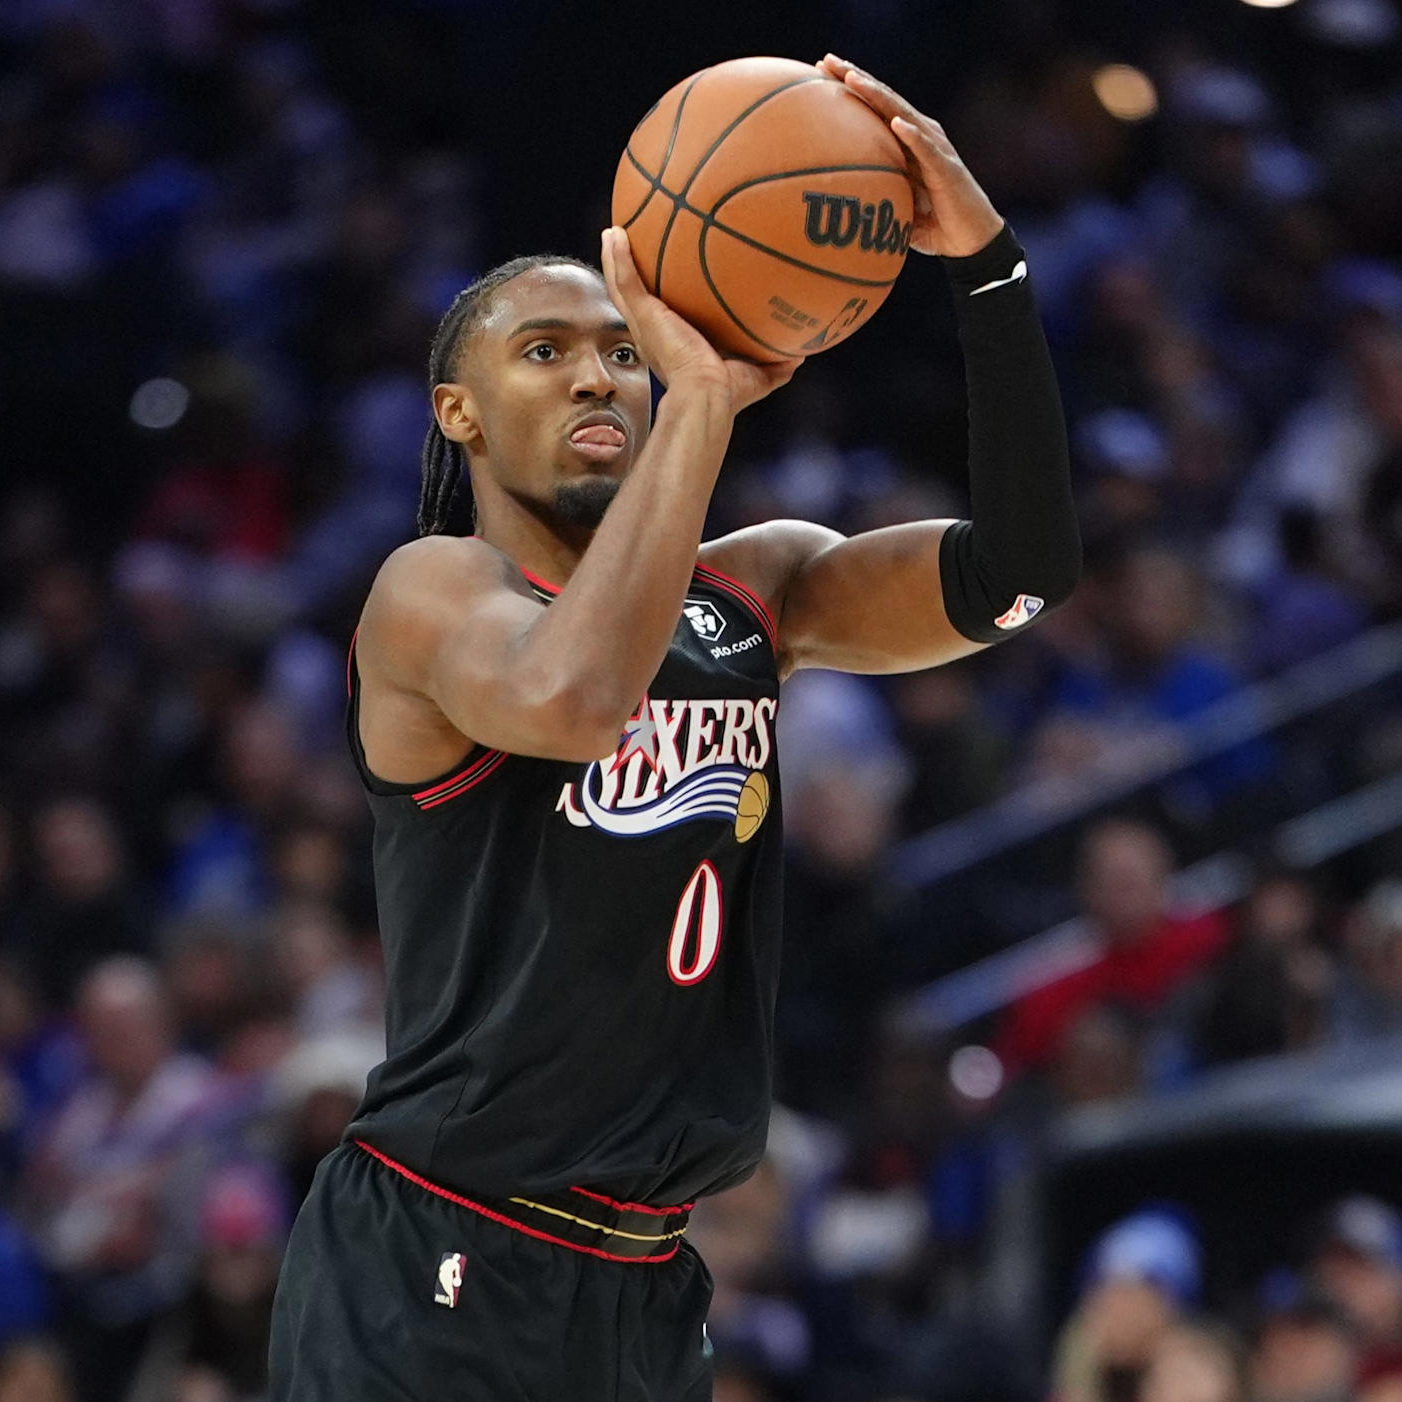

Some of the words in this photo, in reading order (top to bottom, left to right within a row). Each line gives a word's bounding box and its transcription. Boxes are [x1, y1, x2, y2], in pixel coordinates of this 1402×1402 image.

[802, 191, 912, 256] Wilso
[710, 633, 763, 660] pto.com
[665, 858, 724, 987] 0
